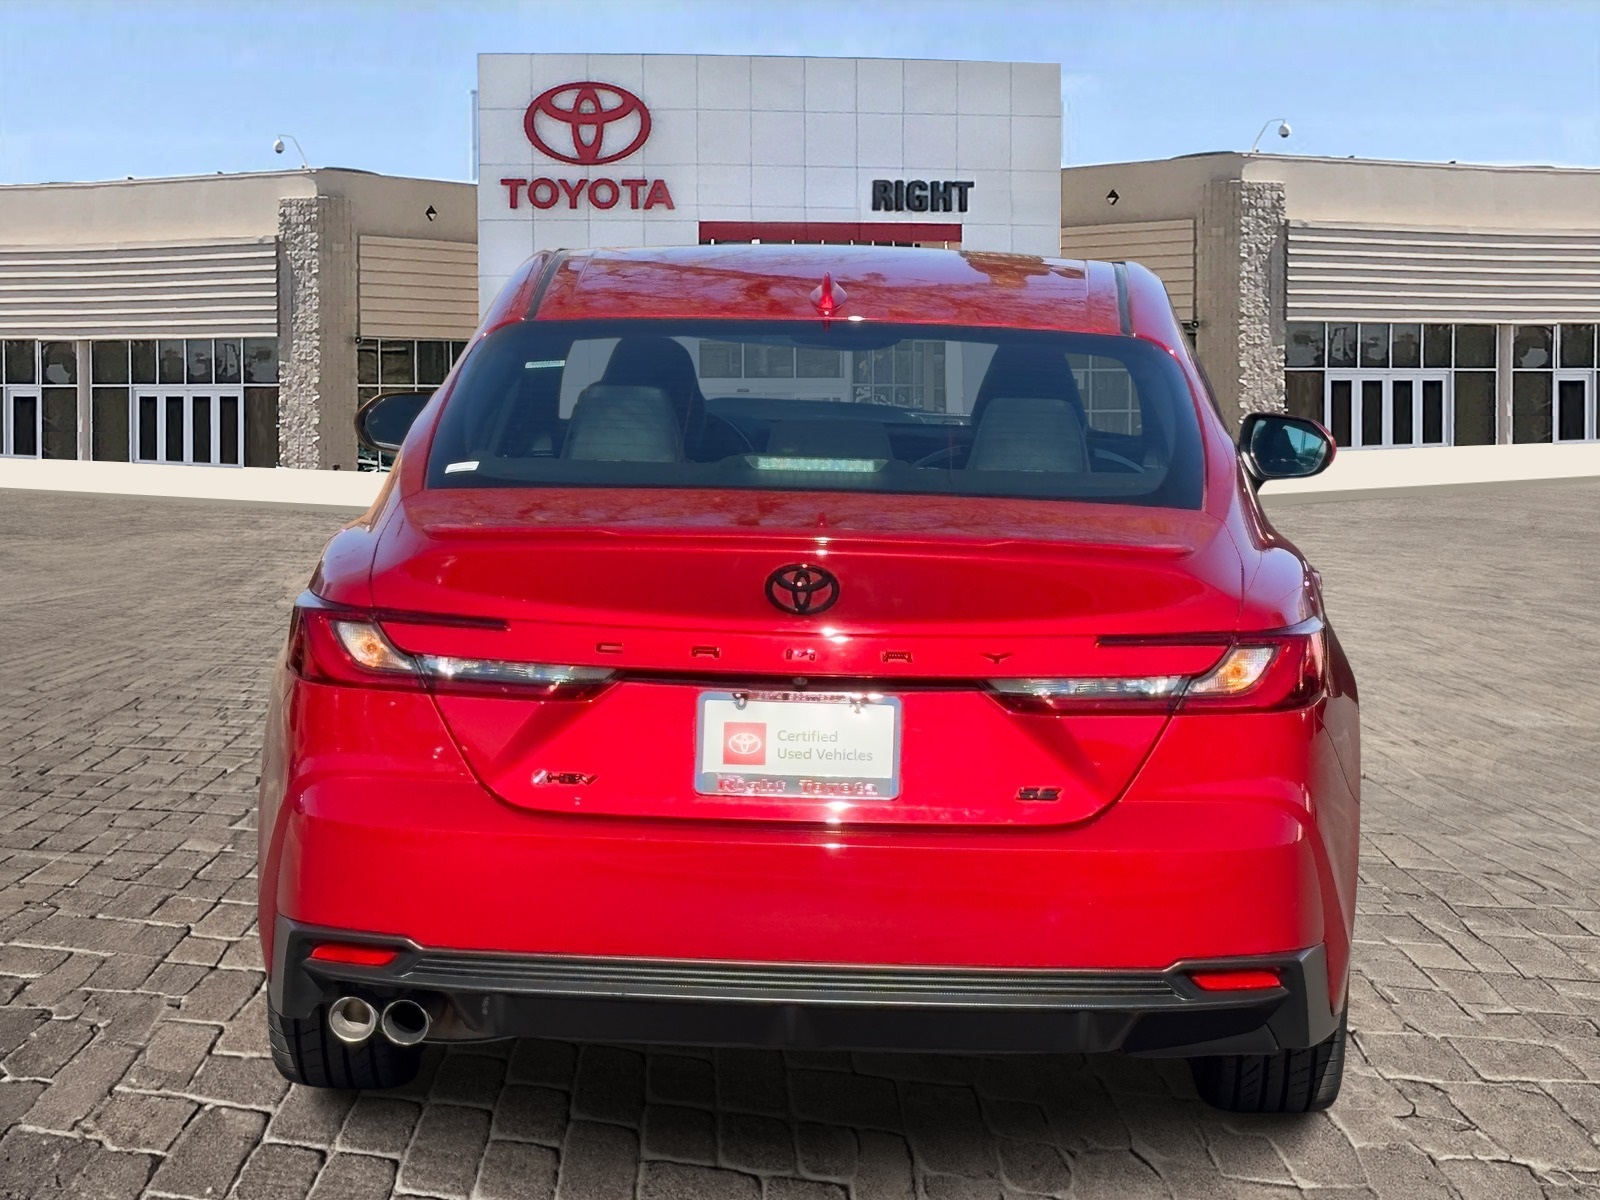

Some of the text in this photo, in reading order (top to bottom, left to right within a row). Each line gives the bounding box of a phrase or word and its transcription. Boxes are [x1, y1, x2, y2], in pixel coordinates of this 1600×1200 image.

[500, 178, 675, 210] TOYOTA
[872, 180, 976, 213] RIGHT
[596, 642, 1013, 665] CAMRY
[777, 729, 838, 743] Certified
[777, 748, 874, 762] Used Vehicles
[798, 779, 879, 796] Toyota
